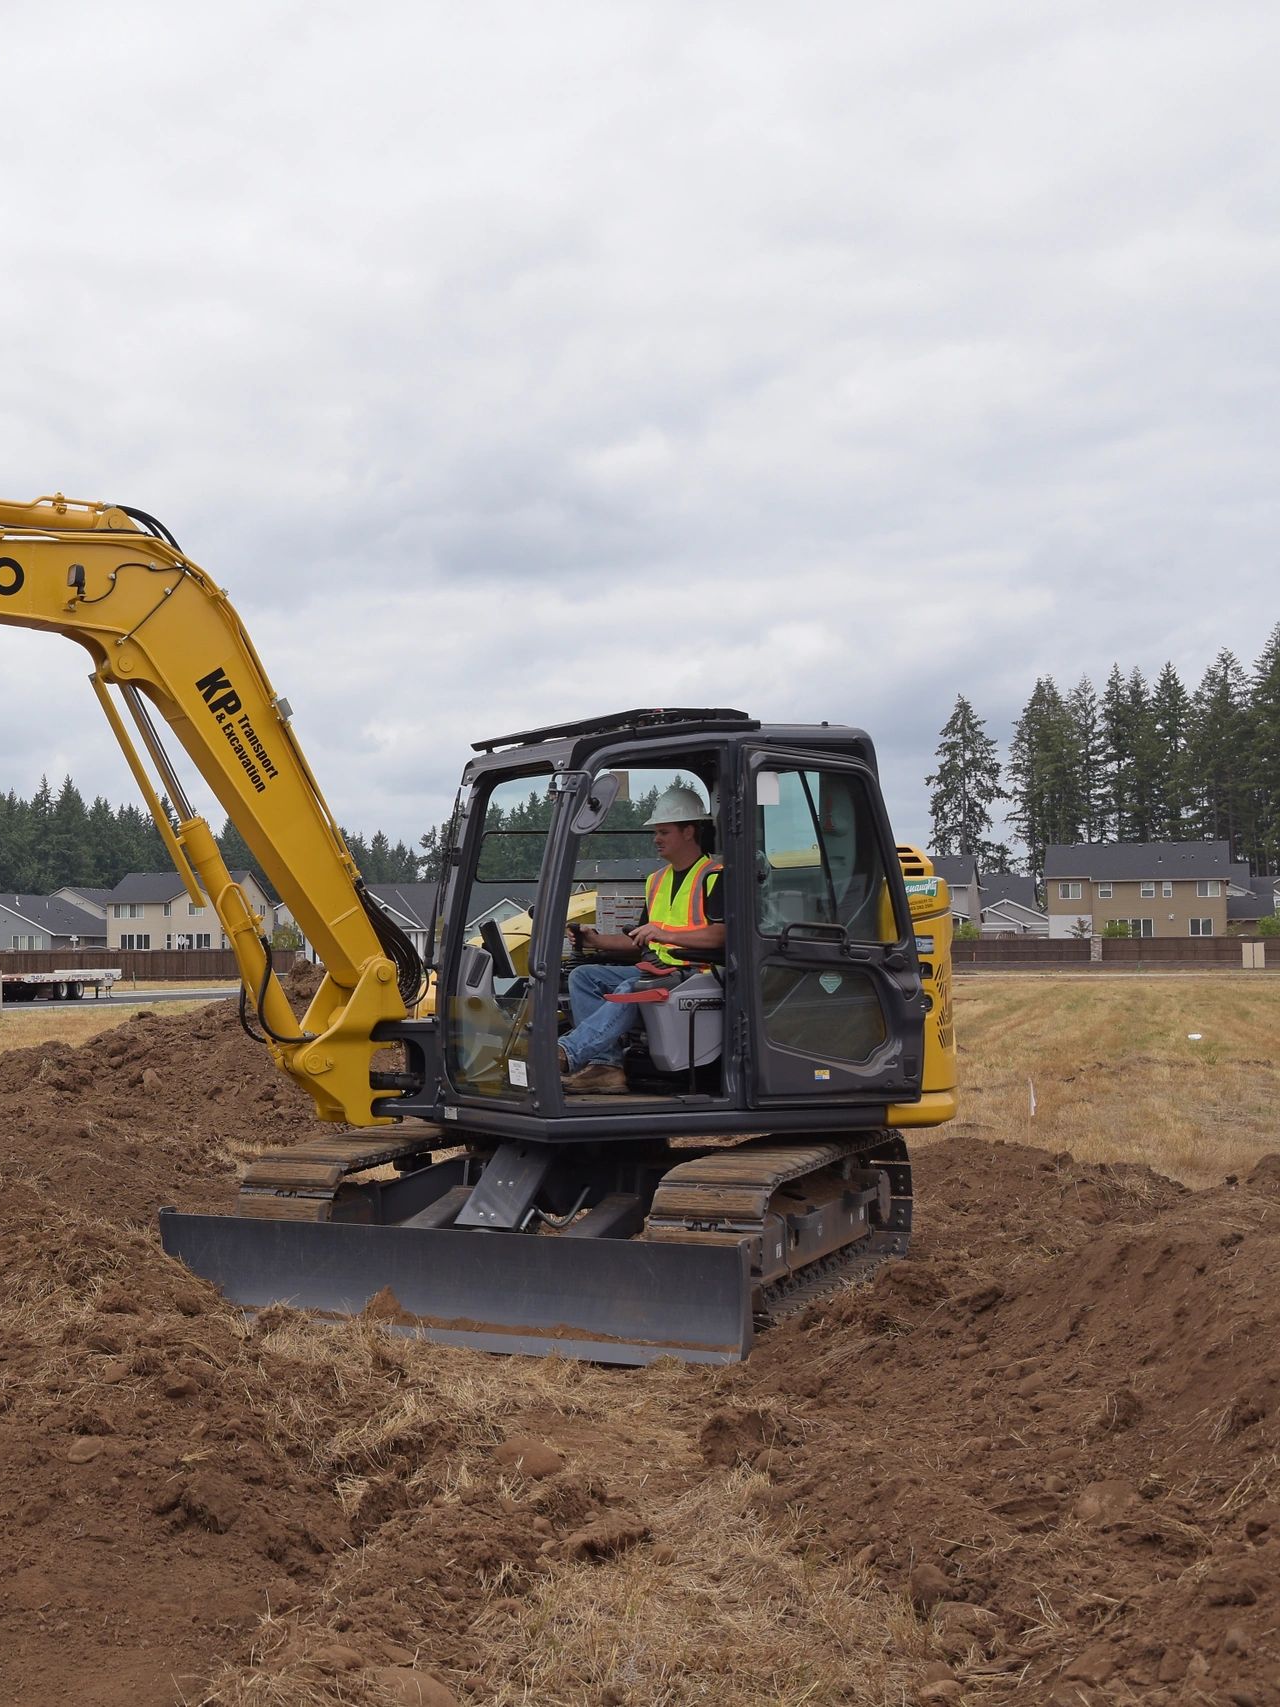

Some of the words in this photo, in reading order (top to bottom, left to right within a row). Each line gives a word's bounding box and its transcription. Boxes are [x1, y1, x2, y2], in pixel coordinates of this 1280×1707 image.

[195, 667, 242, 716] KP
[215, 712, 226, 724] &
[221, 722, 266, 794] Excavation
[237, 713, 279, 780] Transport
